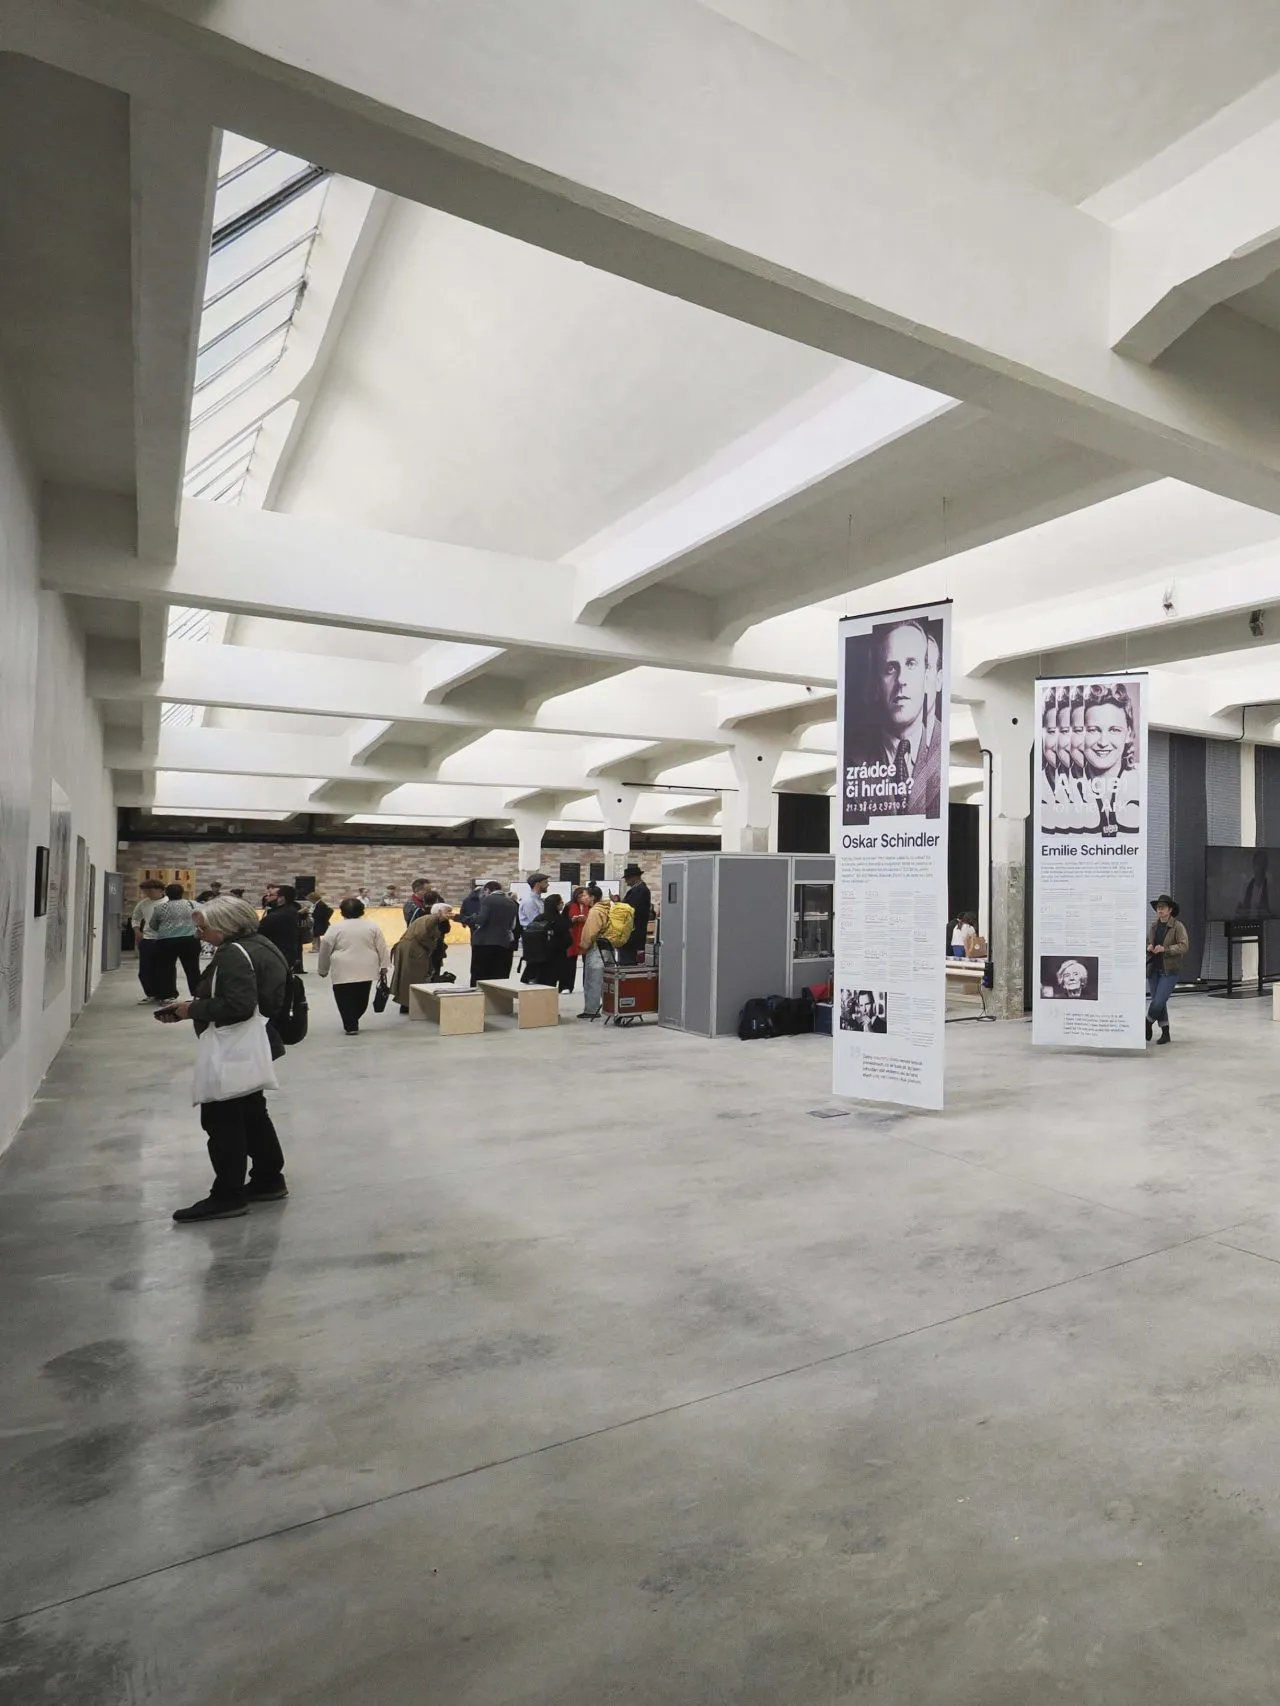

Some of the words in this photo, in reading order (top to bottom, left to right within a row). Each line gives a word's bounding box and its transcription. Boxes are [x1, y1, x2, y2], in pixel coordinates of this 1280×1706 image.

[846, 761, 897, 780] zrádce
[846, 781, 858, 798] či
[861, 777, 915, 797] hrdina?
[842, 834, 878, 849] Oskar
[881, 832, 940, 848] Schindler
[1041, 844, 1078, 857] Emilie
[1081, 844, 1139, 856] Schindler
